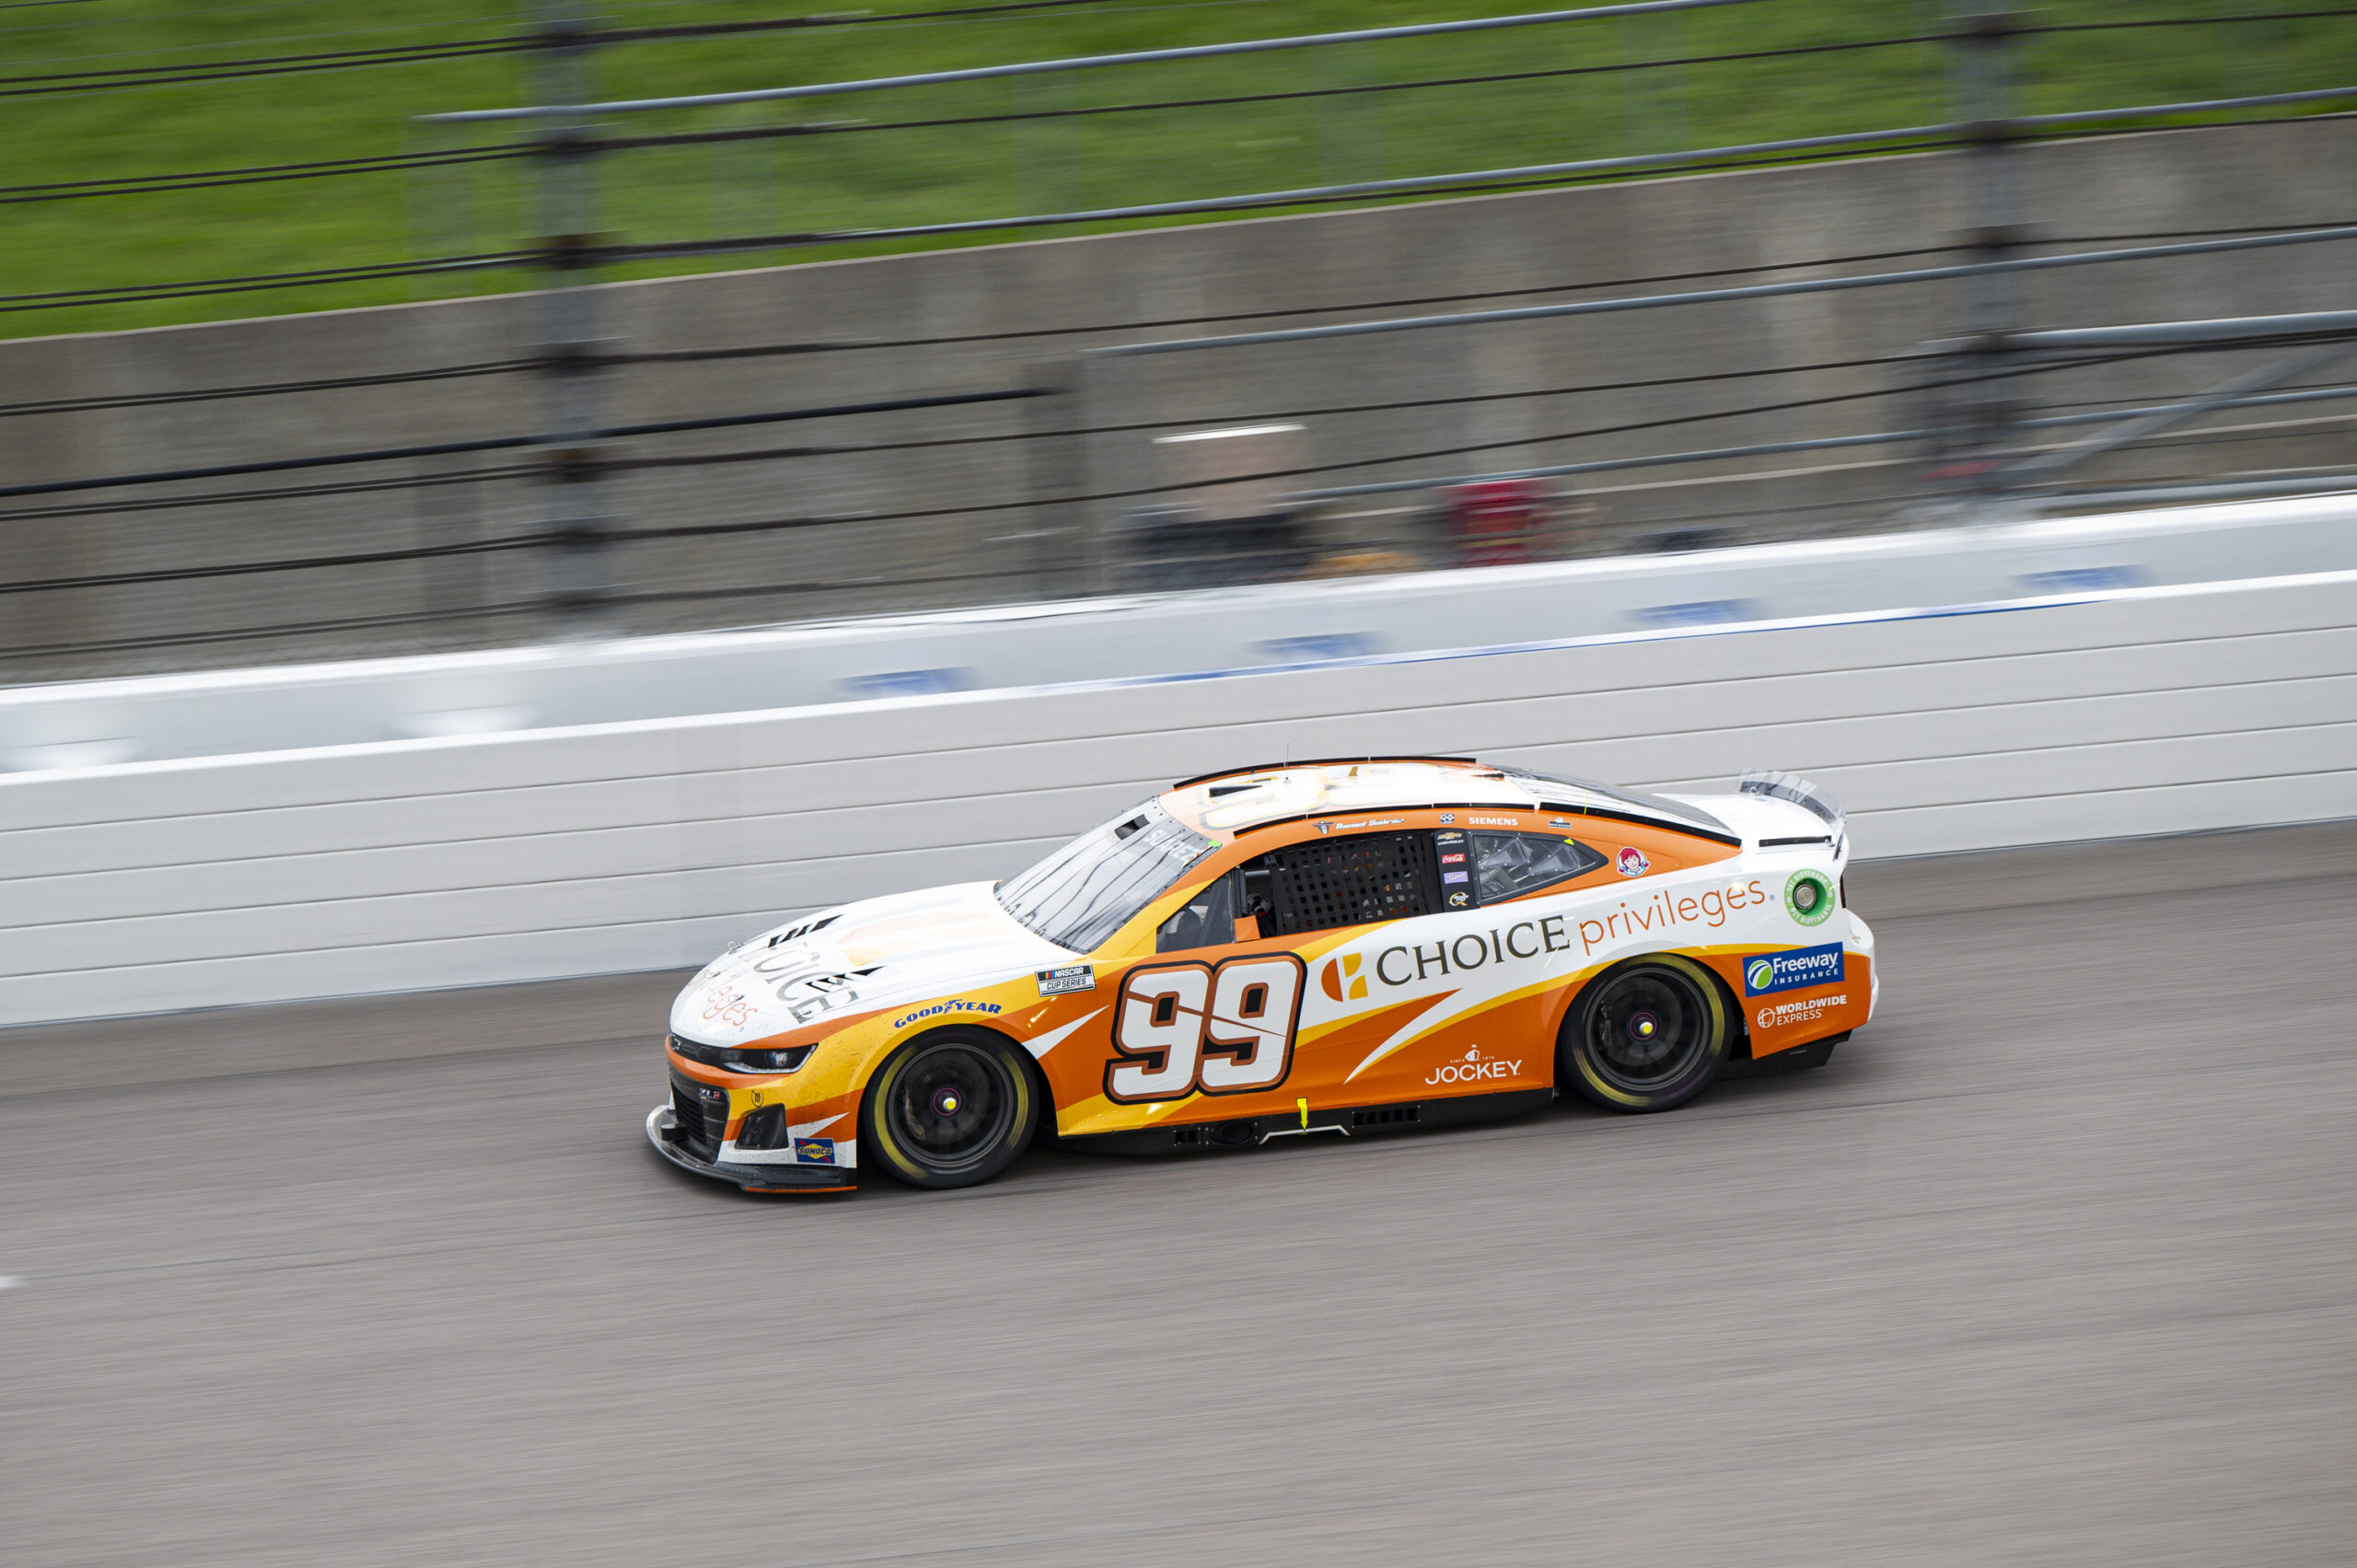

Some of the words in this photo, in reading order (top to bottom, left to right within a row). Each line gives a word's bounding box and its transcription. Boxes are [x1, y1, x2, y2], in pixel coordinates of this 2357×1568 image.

[1469, 817, 1518, 826] SIEMENS
[1376, 914, 1571, 986] CHOICE
[1578, 879, 1766, 957] privileges
[1054, 967, 1084, 978] NASCAR
[1772, 952, 1839, 974] Freeway
[1046, 981, 1062, 991] CUP
[1062, 977, 1086, 988] SERIES
[1774, 968, 1839, 985] INSURANCE
[894, 1001, 1002, 1028] GOODYEAR
[1775, 994, 1847, 1016] WORLDWIDE
[1776, 1009, 1822, 1026] EXPRESS
[1107, 955, 1304, 1102] 99
[1424, 1059, 1522, 1085] JOCKEY
[797, 1146, 832, 1156] SUNOCO
